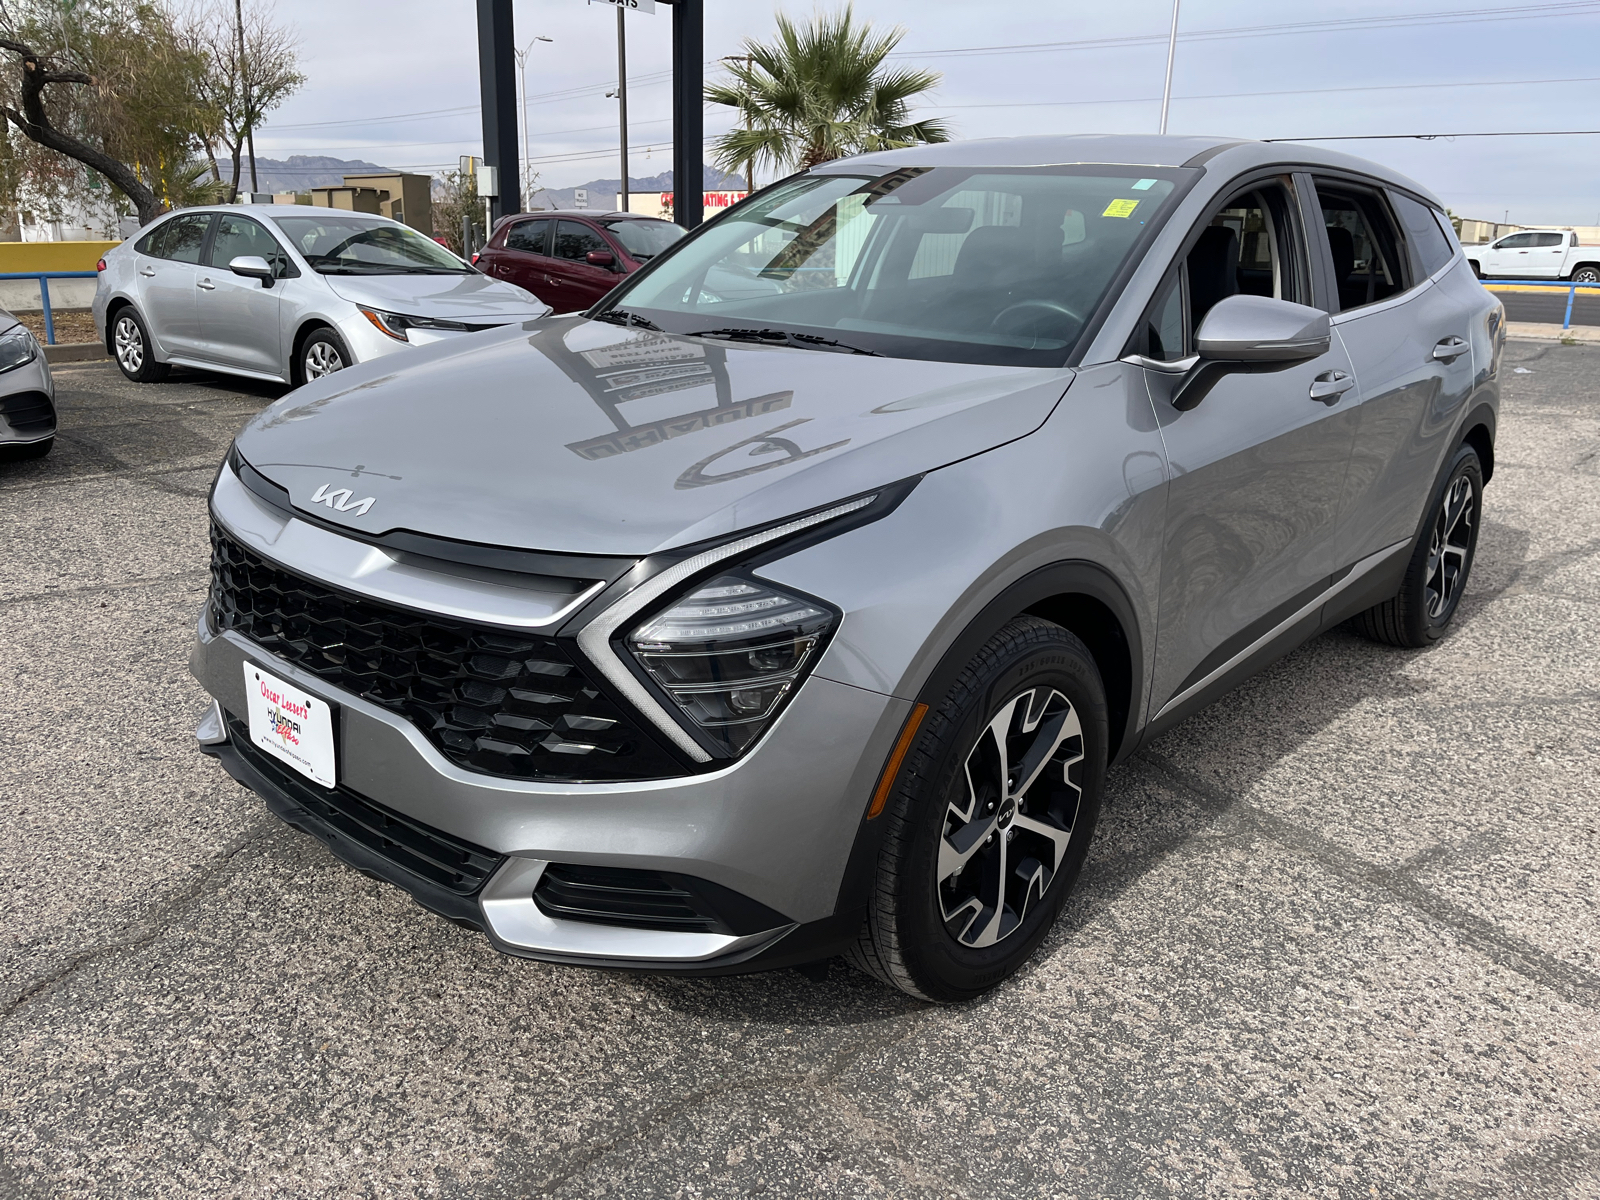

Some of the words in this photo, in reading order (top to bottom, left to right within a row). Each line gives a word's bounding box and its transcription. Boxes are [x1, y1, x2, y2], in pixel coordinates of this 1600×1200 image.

[609, 0, 637, 8] AYS
[703, 193, 728, 207] ATING
[311, 483, 377, 517] KIA
[261, 681, 280, 705] Oscar
[281, 694, 308, 720] Leeser's
[267, 707, 301, 735] HYUNDAI
